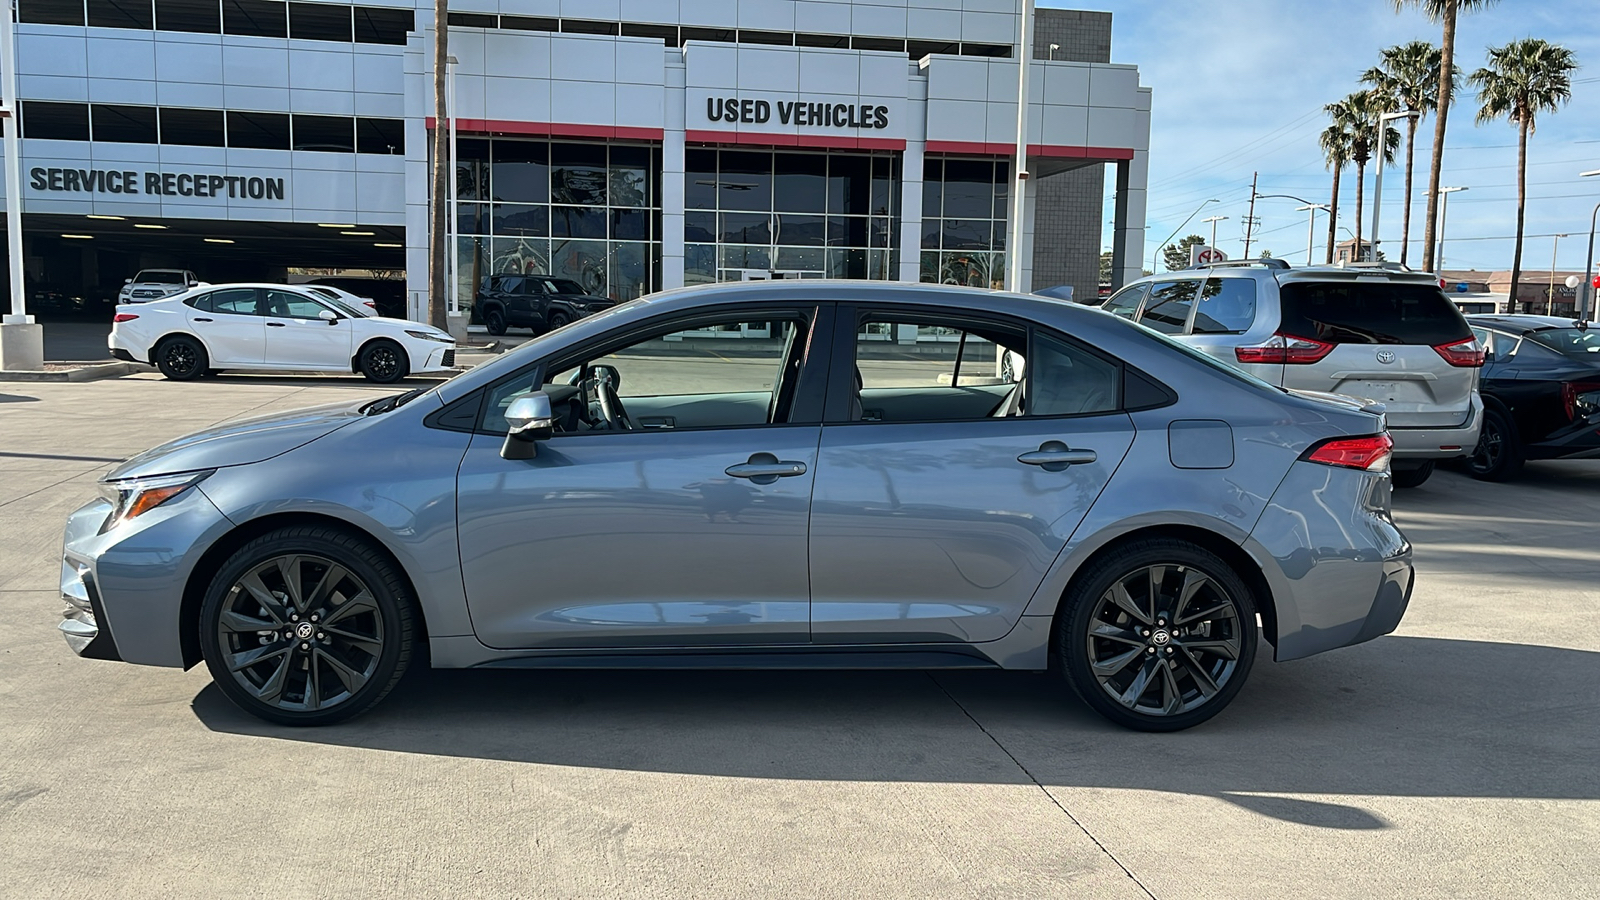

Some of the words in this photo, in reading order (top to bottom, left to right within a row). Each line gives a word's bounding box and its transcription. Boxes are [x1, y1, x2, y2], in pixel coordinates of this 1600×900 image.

[707, 97, 771, 124] USED
[777, 101, 889, 129] VEHICLES
[30, 167, 139, 194] SERVICE
[144, 172, 284, 200] RECEPTION
